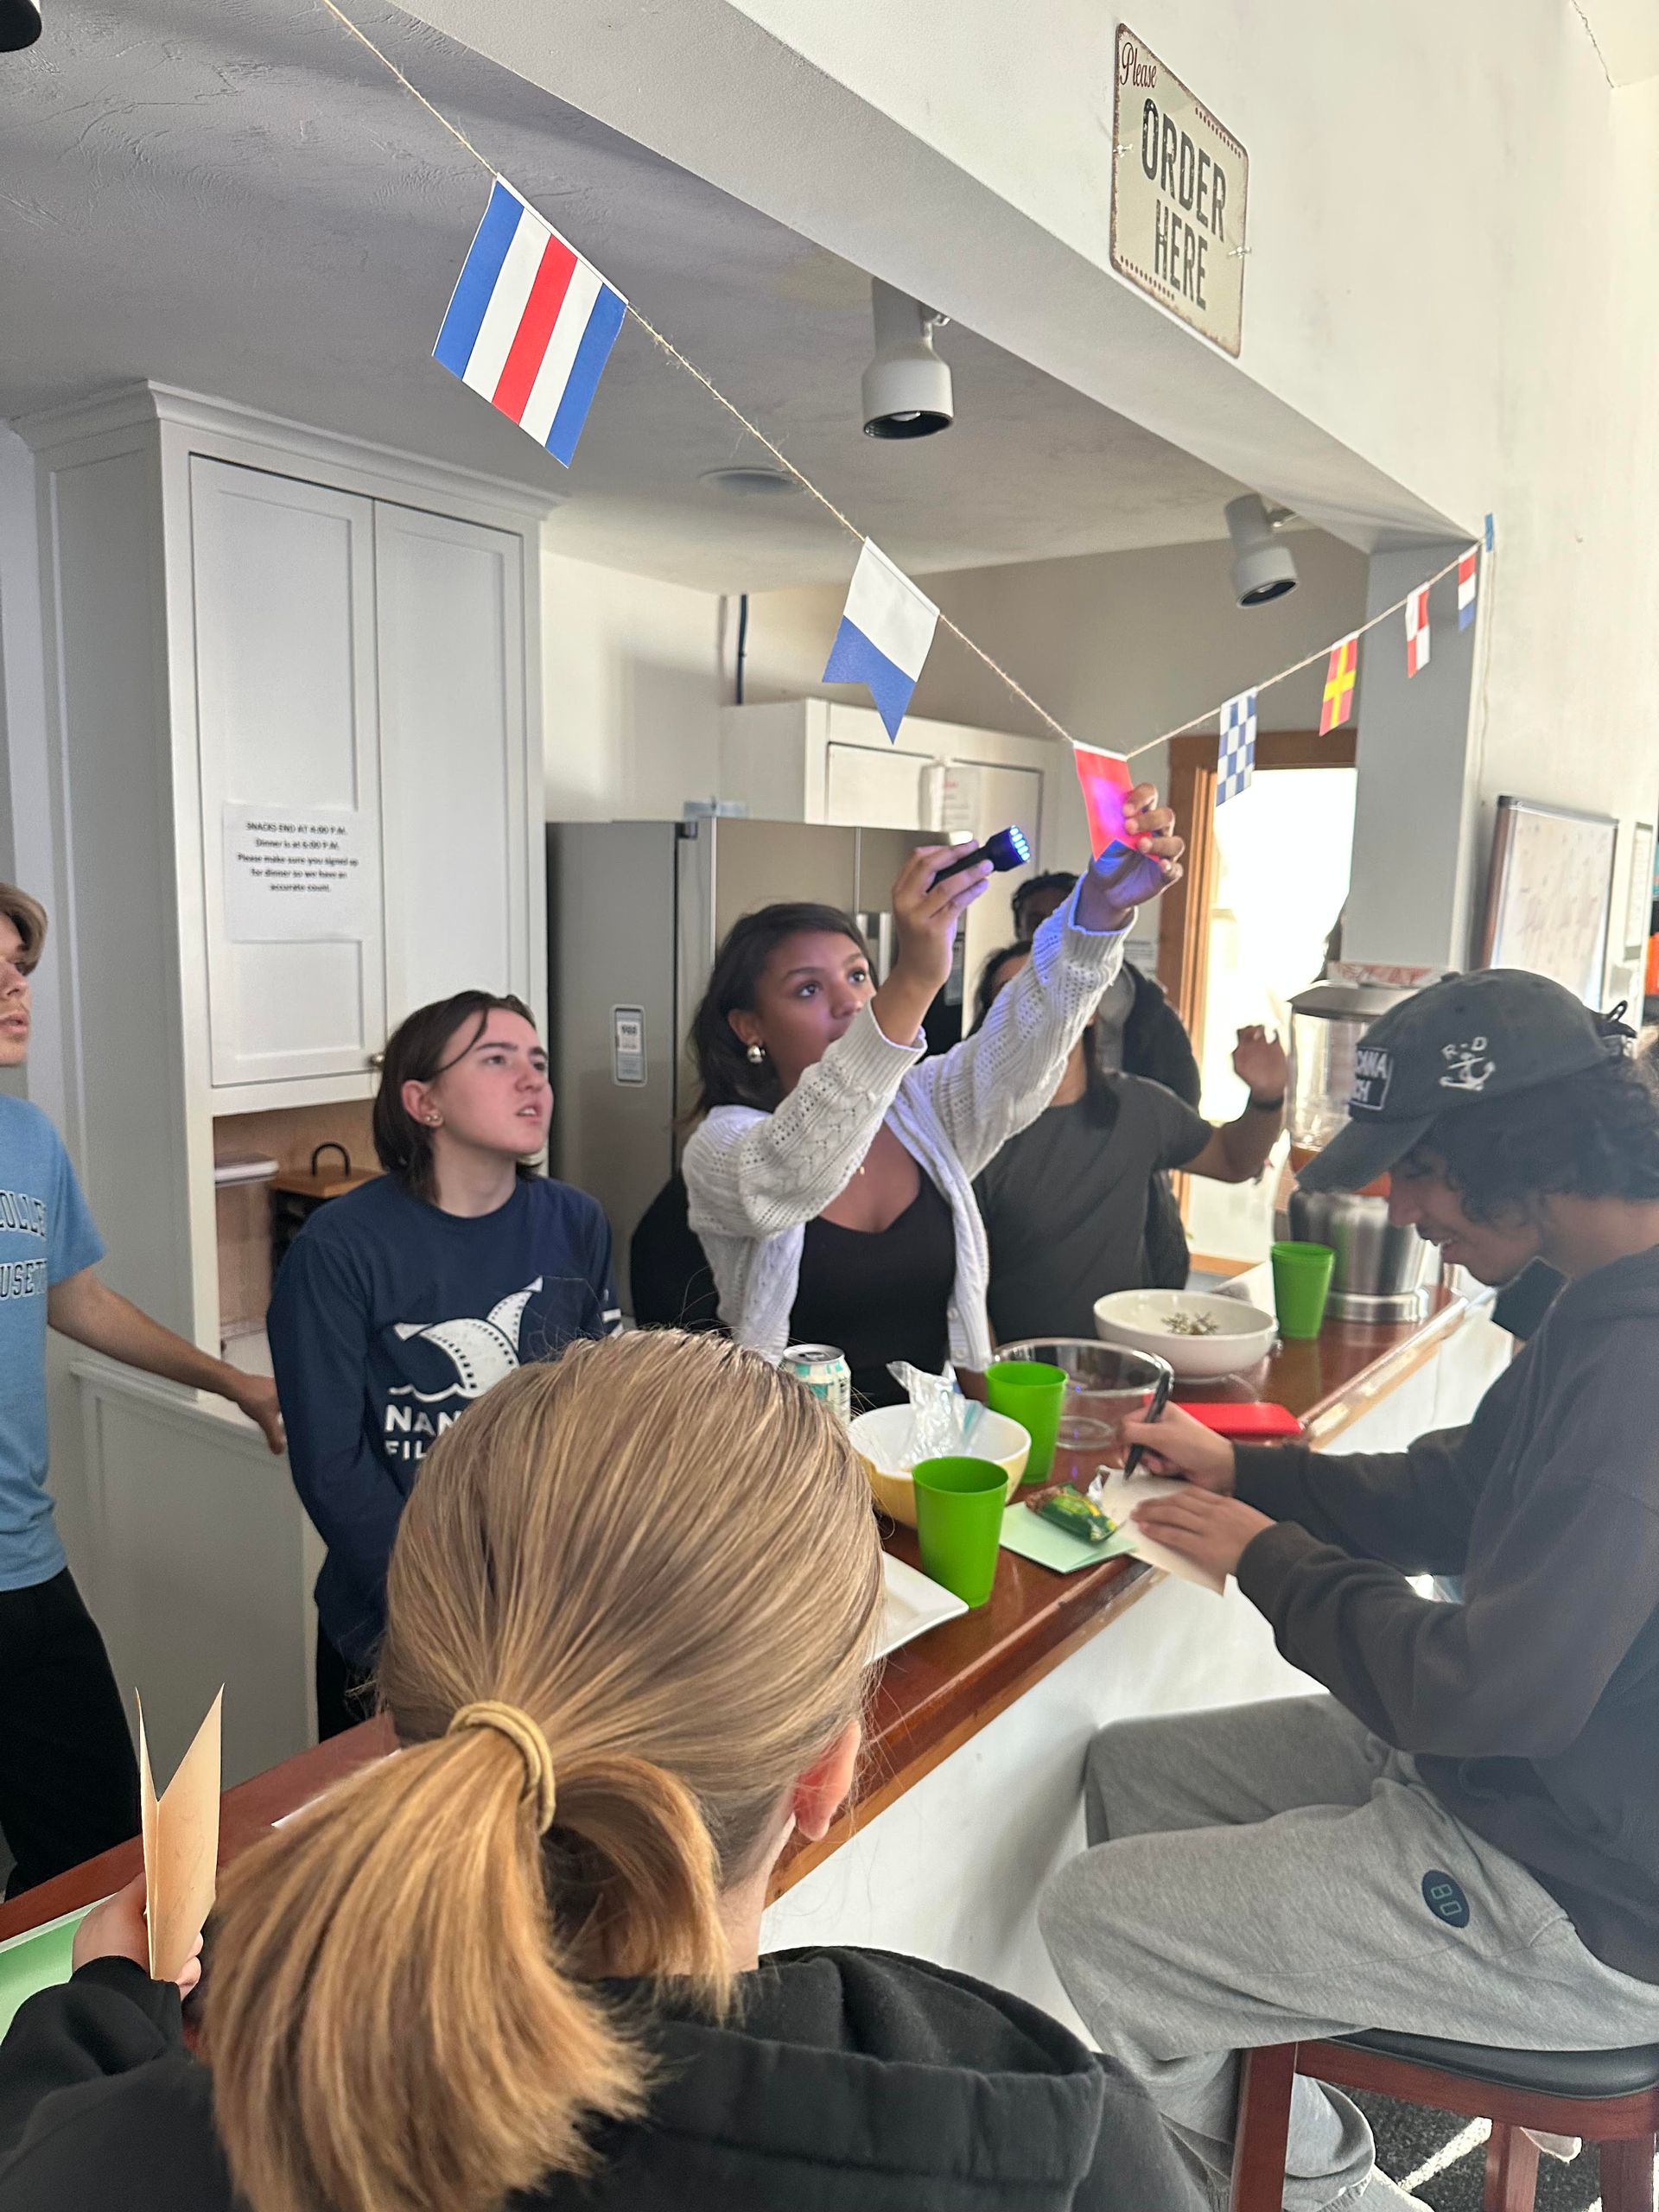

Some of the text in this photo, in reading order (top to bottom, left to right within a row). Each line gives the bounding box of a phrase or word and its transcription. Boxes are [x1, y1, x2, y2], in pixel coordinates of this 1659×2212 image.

[1120, 41, 1158, 90] Please
[1141, 97, 1227, 243] ORDER
[1154, 198, 1209, 311] HERE
[245, 822, 276, 832] SNACKS
[278, 823, 296, 833] END
[297, 824, 308, 834] AT
[255, 838, 282, 848] Dinner
[283, 839, 291, 848] is
[292, 840, 301, 849] at
[238, 852, 261, 862] Please
[263, 854, 286, 863] make
[307, 856, 323, 866] you
[324, 855, 348, 867] signed
[251, 868, 263, 877] for
[264, 868, 291, 878] dinner
[318, 869, 337, 879] have
[270, 883, 331, 893] accurate count.
